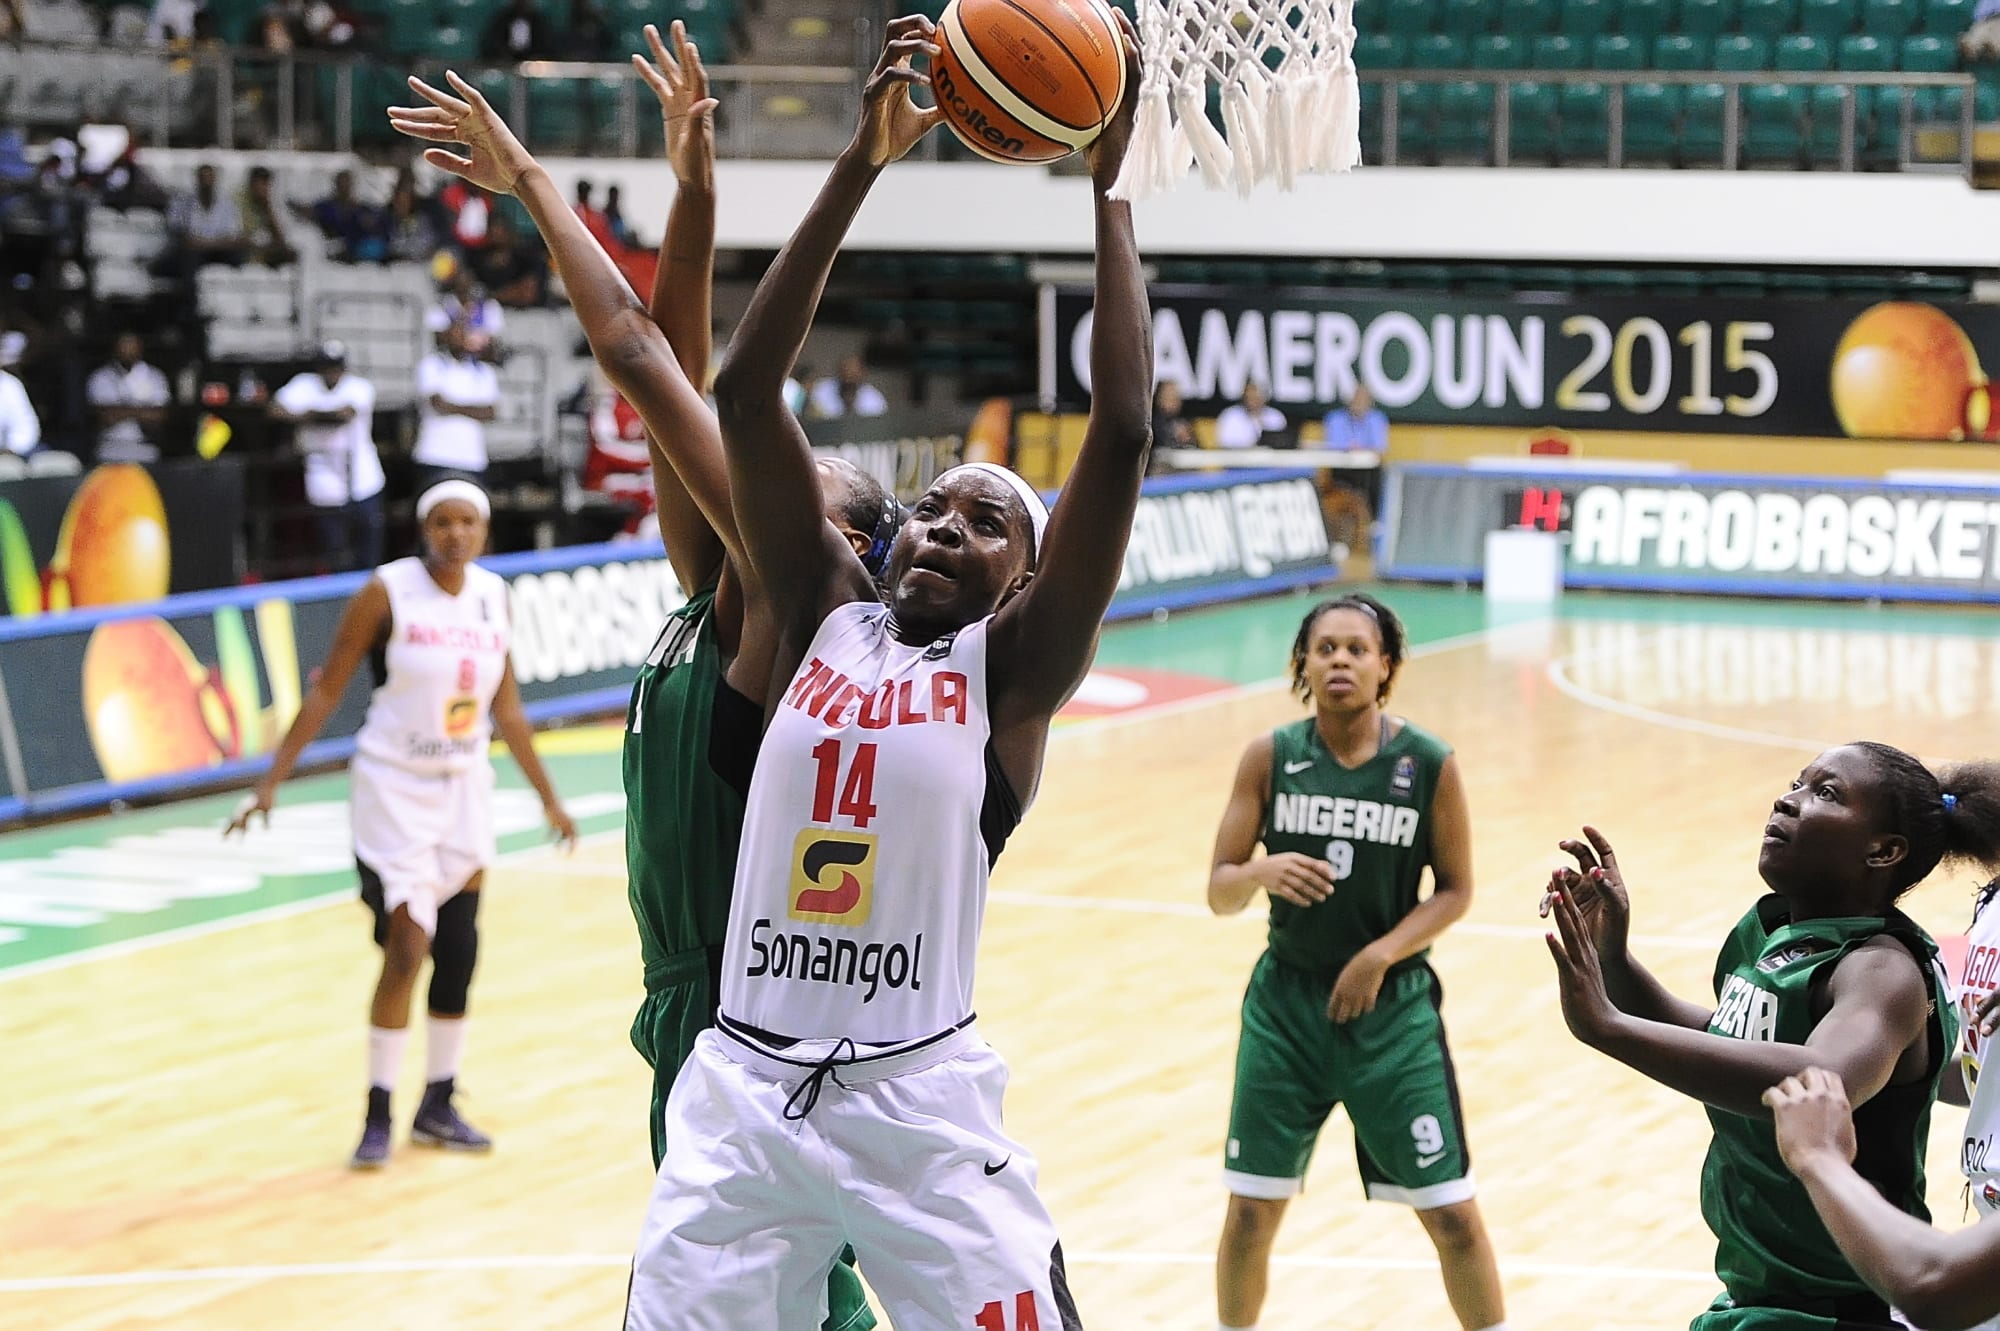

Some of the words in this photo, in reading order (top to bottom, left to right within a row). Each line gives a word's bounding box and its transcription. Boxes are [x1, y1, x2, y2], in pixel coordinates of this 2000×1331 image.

[936, 66, 1025, 154] molten
[1556, 314, 1779, 417] 2015
[812, 738, 878, 828] 14
[1273, 792, 1420, 848] NIGERIA
[1325, 839, 1355, 881] 9
[746, 918, 923, 1004] Sonangol
[1410, 1113, 1445, 1155] 9
